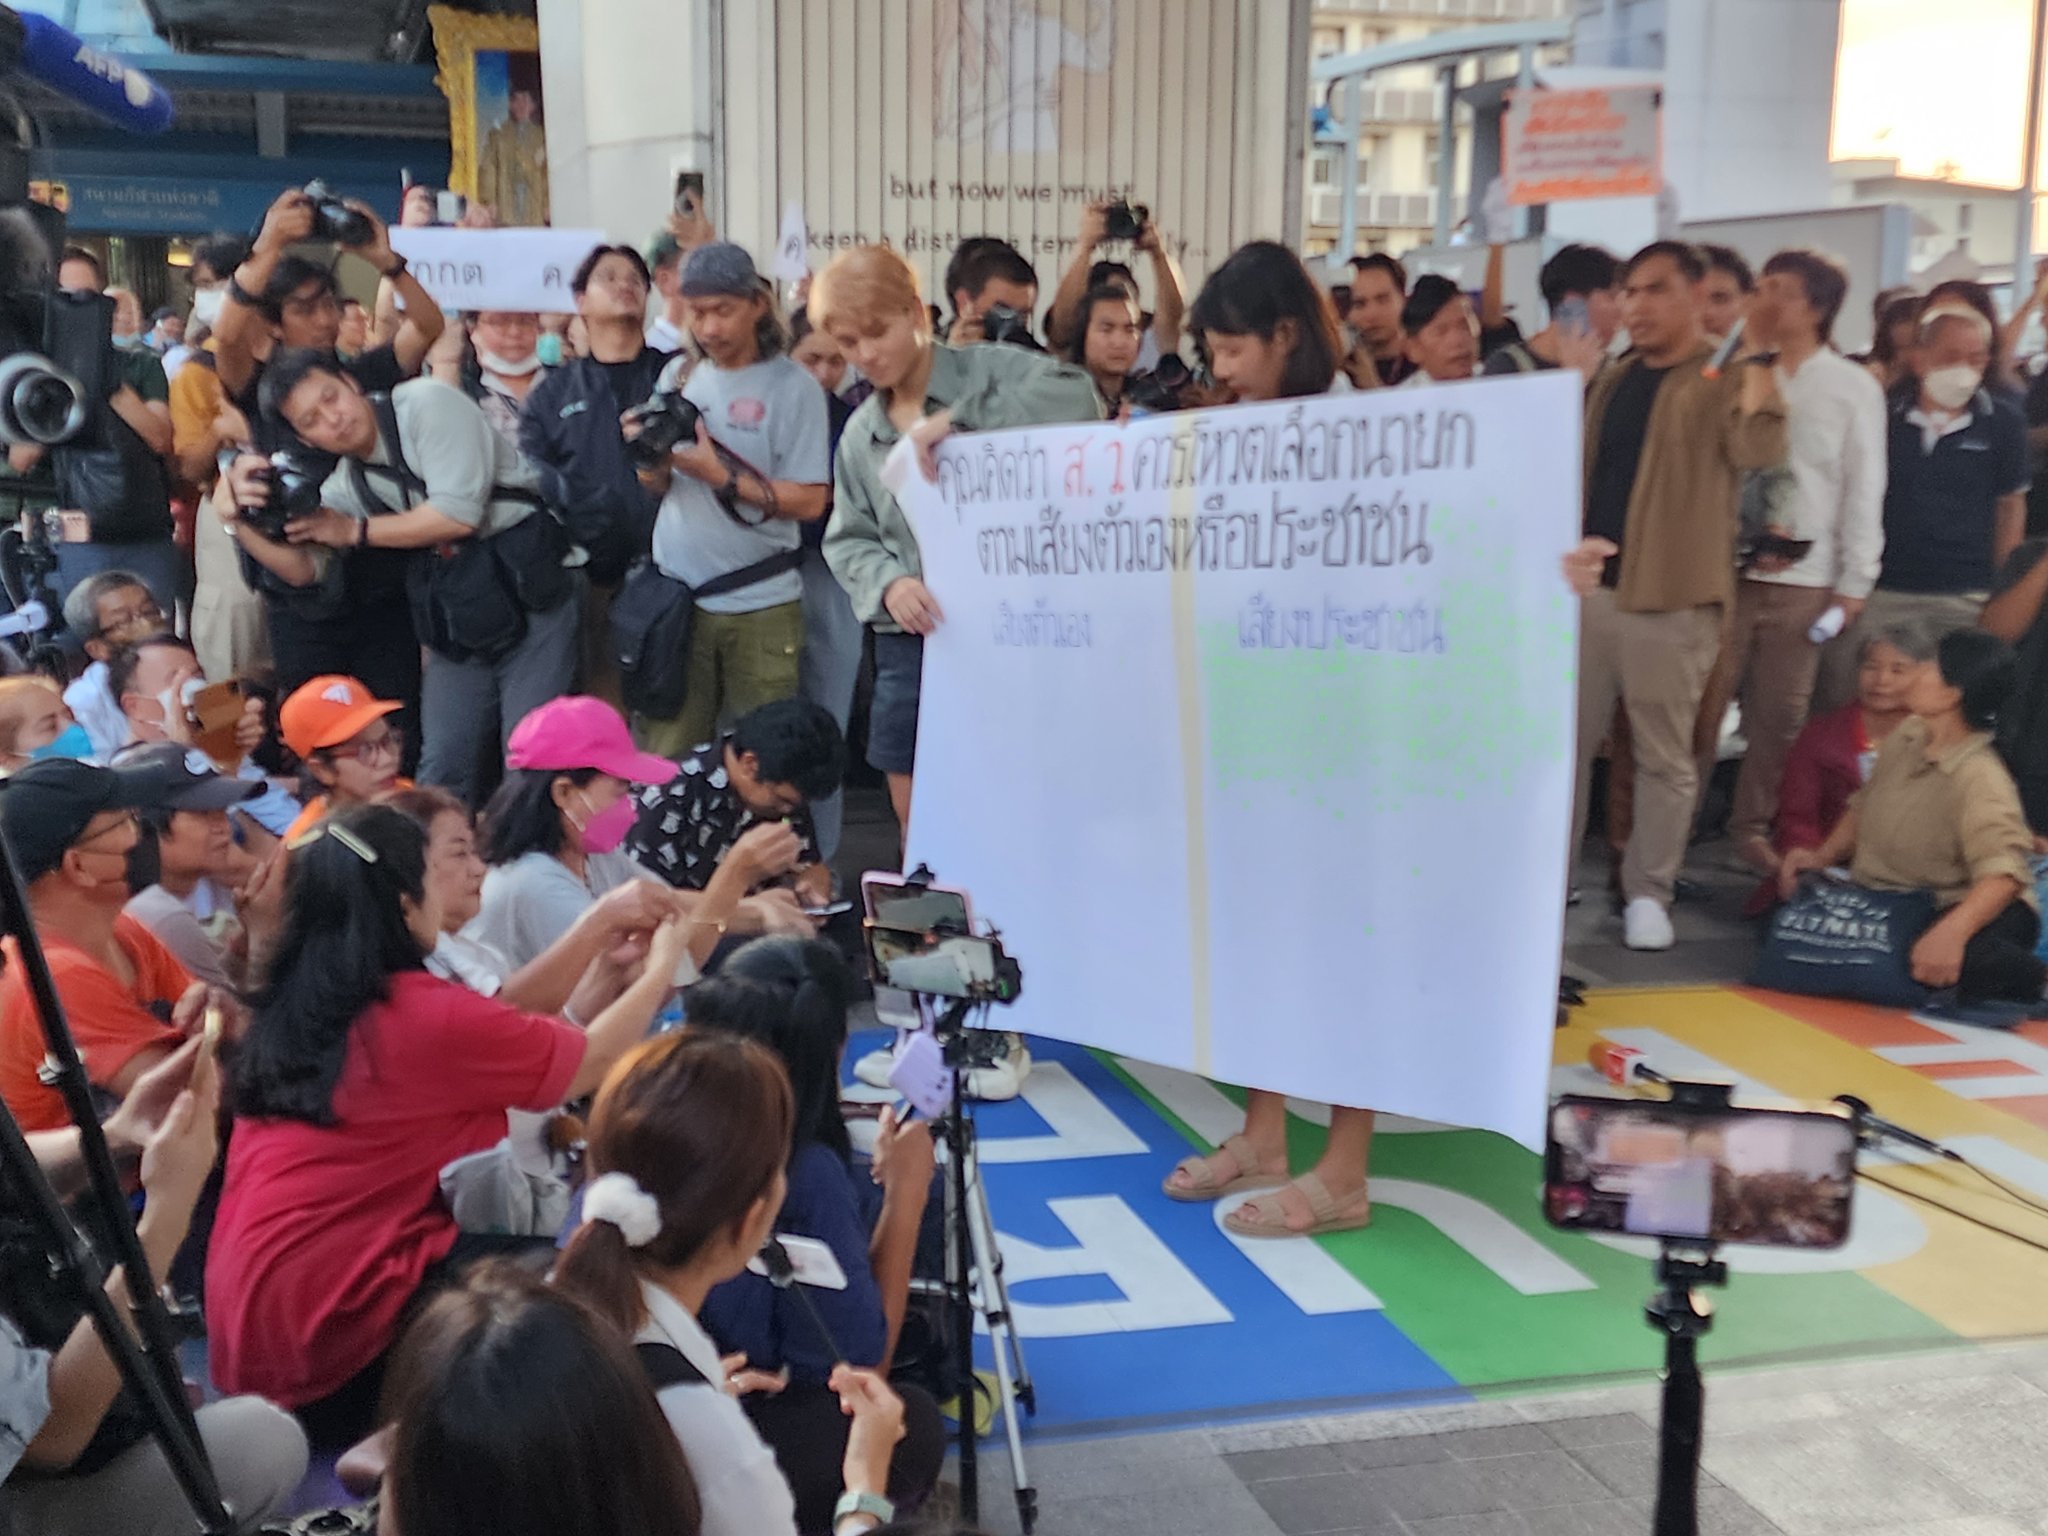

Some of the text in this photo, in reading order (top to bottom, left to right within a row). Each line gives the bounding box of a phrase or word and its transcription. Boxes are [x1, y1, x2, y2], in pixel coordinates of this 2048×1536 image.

[74, 45, 125, 84] AFP
[890, 174, 938, 200] but
[949, 183, 1002, 200] now
[1014, 184, 1051, 201] we
